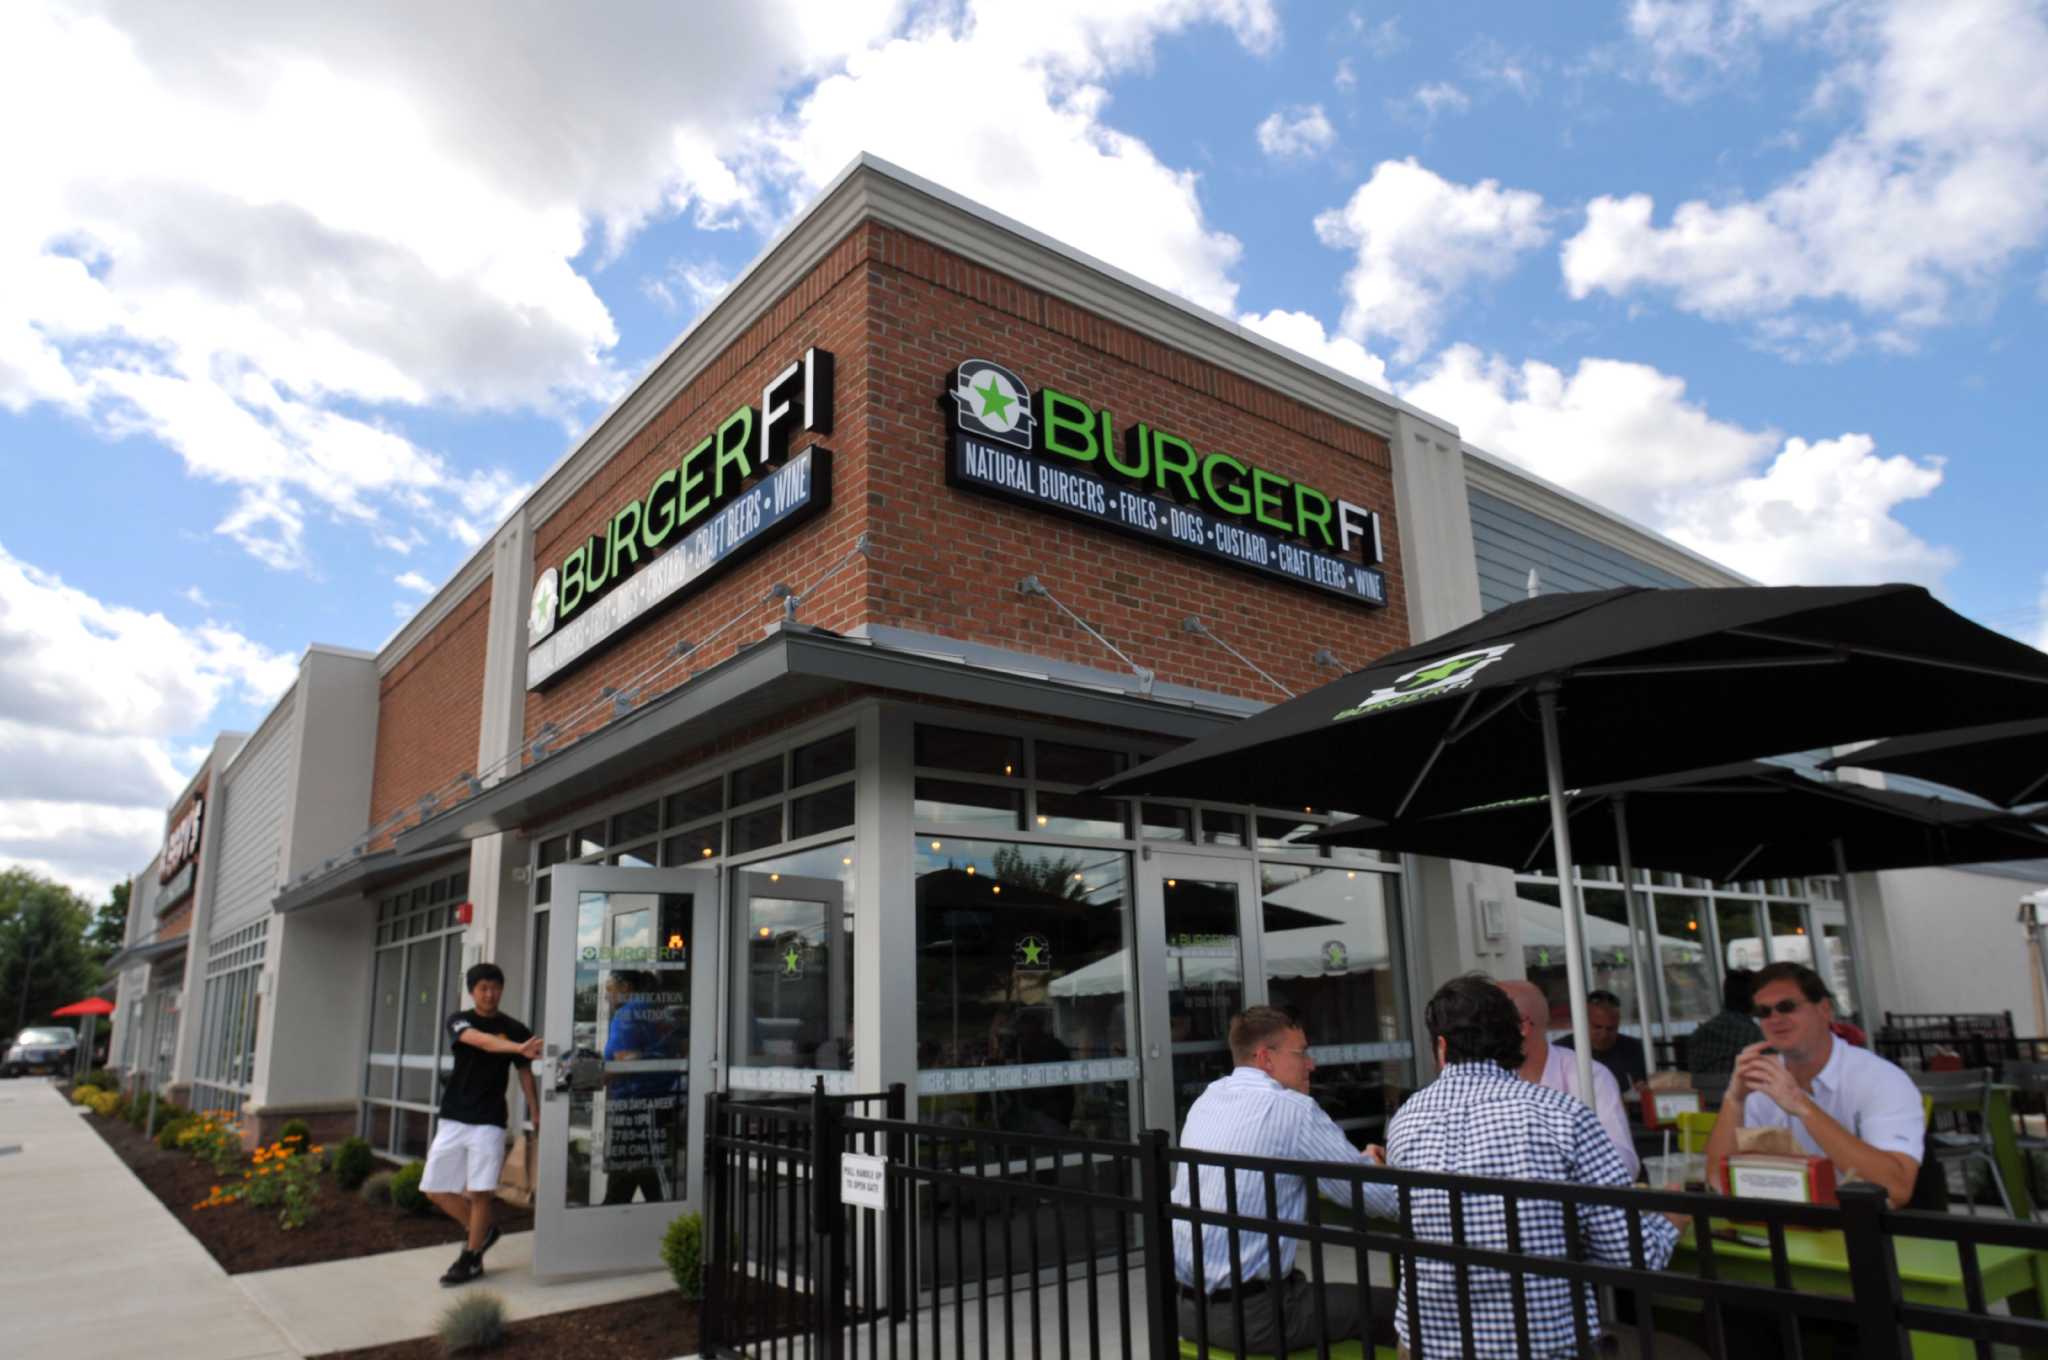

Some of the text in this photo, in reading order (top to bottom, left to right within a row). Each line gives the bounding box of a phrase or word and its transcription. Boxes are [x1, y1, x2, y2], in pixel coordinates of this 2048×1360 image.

[560, 347, 815, 619] BURGERFI
[695, 514, 726, 570] CRAFT
[727, 488, 762, 548] BEERS
[774, 456, 808, 516] WINE
[964, 442, 1384, 601] NATURAL BURGERS FRIES DOGS CUSTARD CRAFT BEERS WINE
[1042, 388, 1384, 564] BURGERFI
